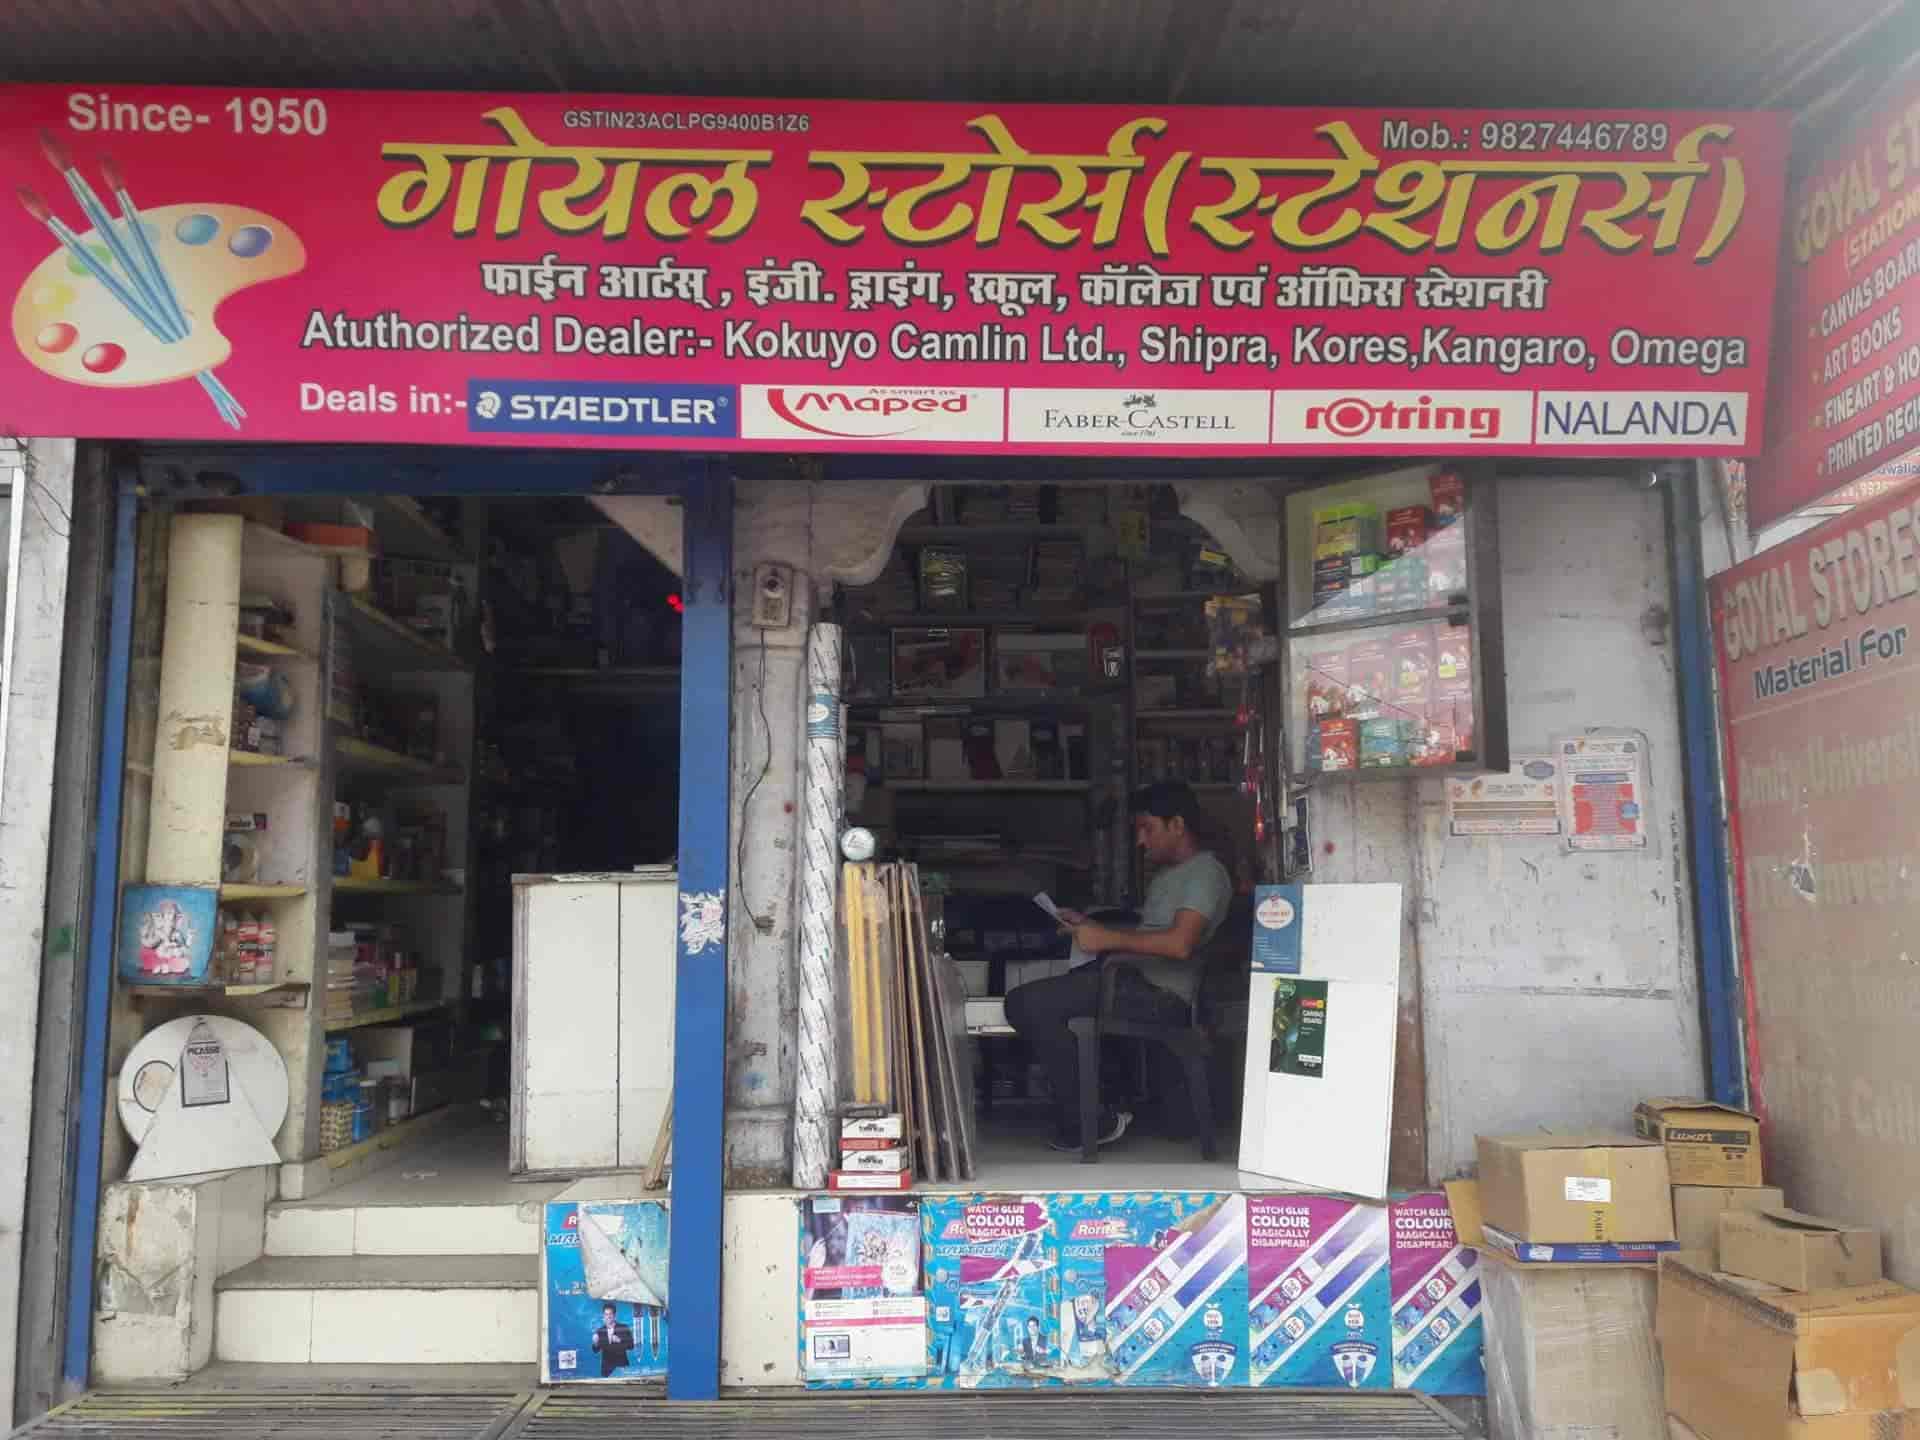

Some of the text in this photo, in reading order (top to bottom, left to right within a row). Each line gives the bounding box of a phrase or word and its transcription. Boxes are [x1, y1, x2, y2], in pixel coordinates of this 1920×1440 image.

[68, 93, 328, 136] Since- 1950
[1382, 120, 1669, 152] Mob.: 9827446789
[376, 106, 773, 238] गोयल
[1080, 263, 1202, 308] कॉलेज
[1211, 265, 1268, 308] एवं
[1276, 266, 1406, 309] ऑफिस
[1415, 268, 1550, 311] स्टेशनरी
[1821, 276, 1873, 336] CANVAS
[303, 311, 540, 354] Atuthorized
[555, 316, 712, 358] Dealer:-
[724, 320, 878, 369] Kokuyo
[890, 323, 1027, 362] Camlin
[1041, 325, 1126, 369] Ltd.,
[1140, 327, 1279, 373] Shipra,
[1611, 329, 1746, 373] Omega
[1823, 305, 1903, 385] ART BOOKS
[300, 382, 399, 413] Deals
[511, 395, 718, 425] STAEDTLER
[1305, 394, 1501, 438] rotring
[1544, 401, 1737, 437] NALANDA
[1825, 368, 1882, 430] FINEART
[1828, 418, 1882, 476] PRINTED
[1723, 558, 1808, 665] GOYAL
[1754, 624, 1910, 700] Material For
[966, 1214, 1025, 1227] COLOUR
[967, 1204, 999, 1214] WATCH
[1251, 1206, 1310, 1215] WATCH GLUE
[1251, 1215, 1310, 1228] COLOUR
[1395, 1208, 1427, 1217] WATCH
[1395, 1217, 1453, 1230] COLOUR
[1251, 1229, 1310, 1239] MAGICALLY
[1396, 1231, 1453, 1240] MAGICALLY
